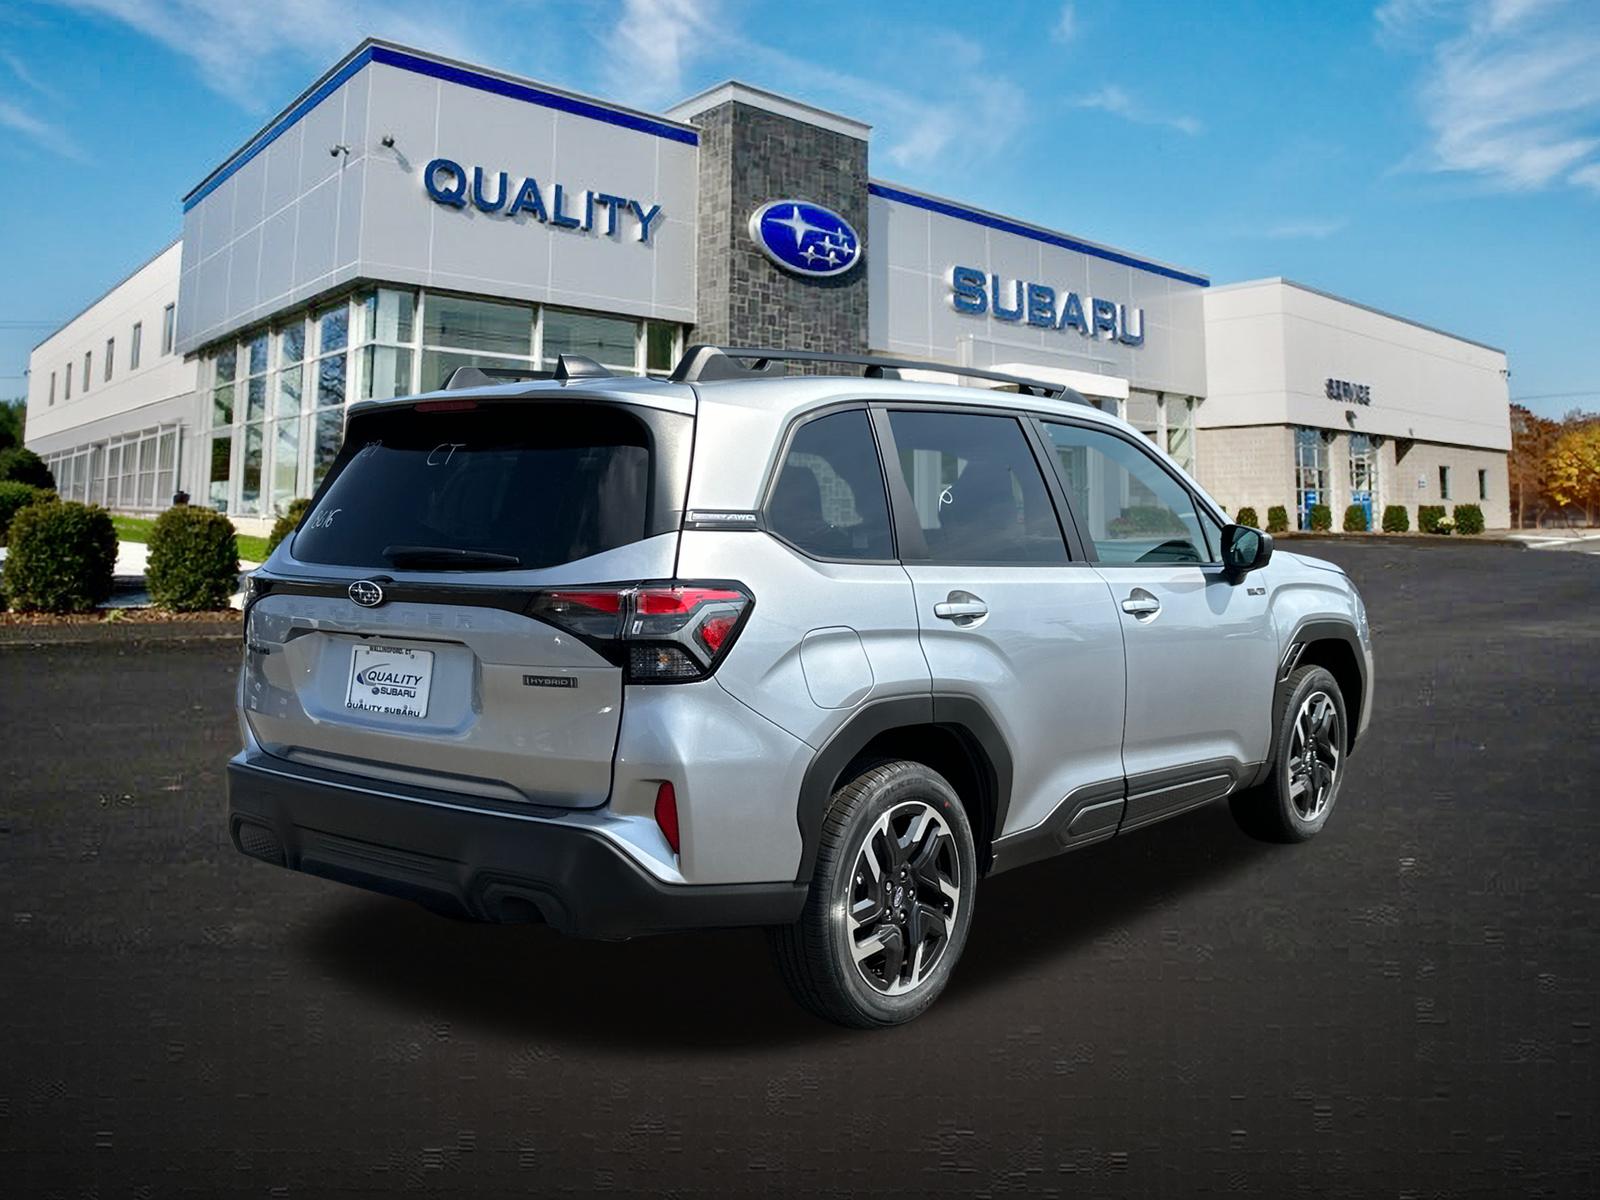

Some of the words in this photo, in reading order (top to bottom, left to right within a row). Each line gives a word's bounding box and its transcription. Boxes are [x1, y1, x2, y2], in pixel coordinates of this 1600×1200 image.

[423, 158, 662, 243] QUALITY
[948, 265, 1145, 347] SUBARU
[1325, 377, 1371, 407] SERVICE
[426, 443, 467, 466] CT
[367, 671, 423, 686] QUALITY
[529, 677, 569, 686] HYBRID
[380, 687, 417, 698] SUBARU
[346, 702, 382, 712] QUALITY
[384, 706, 420, 717] SUBARU
